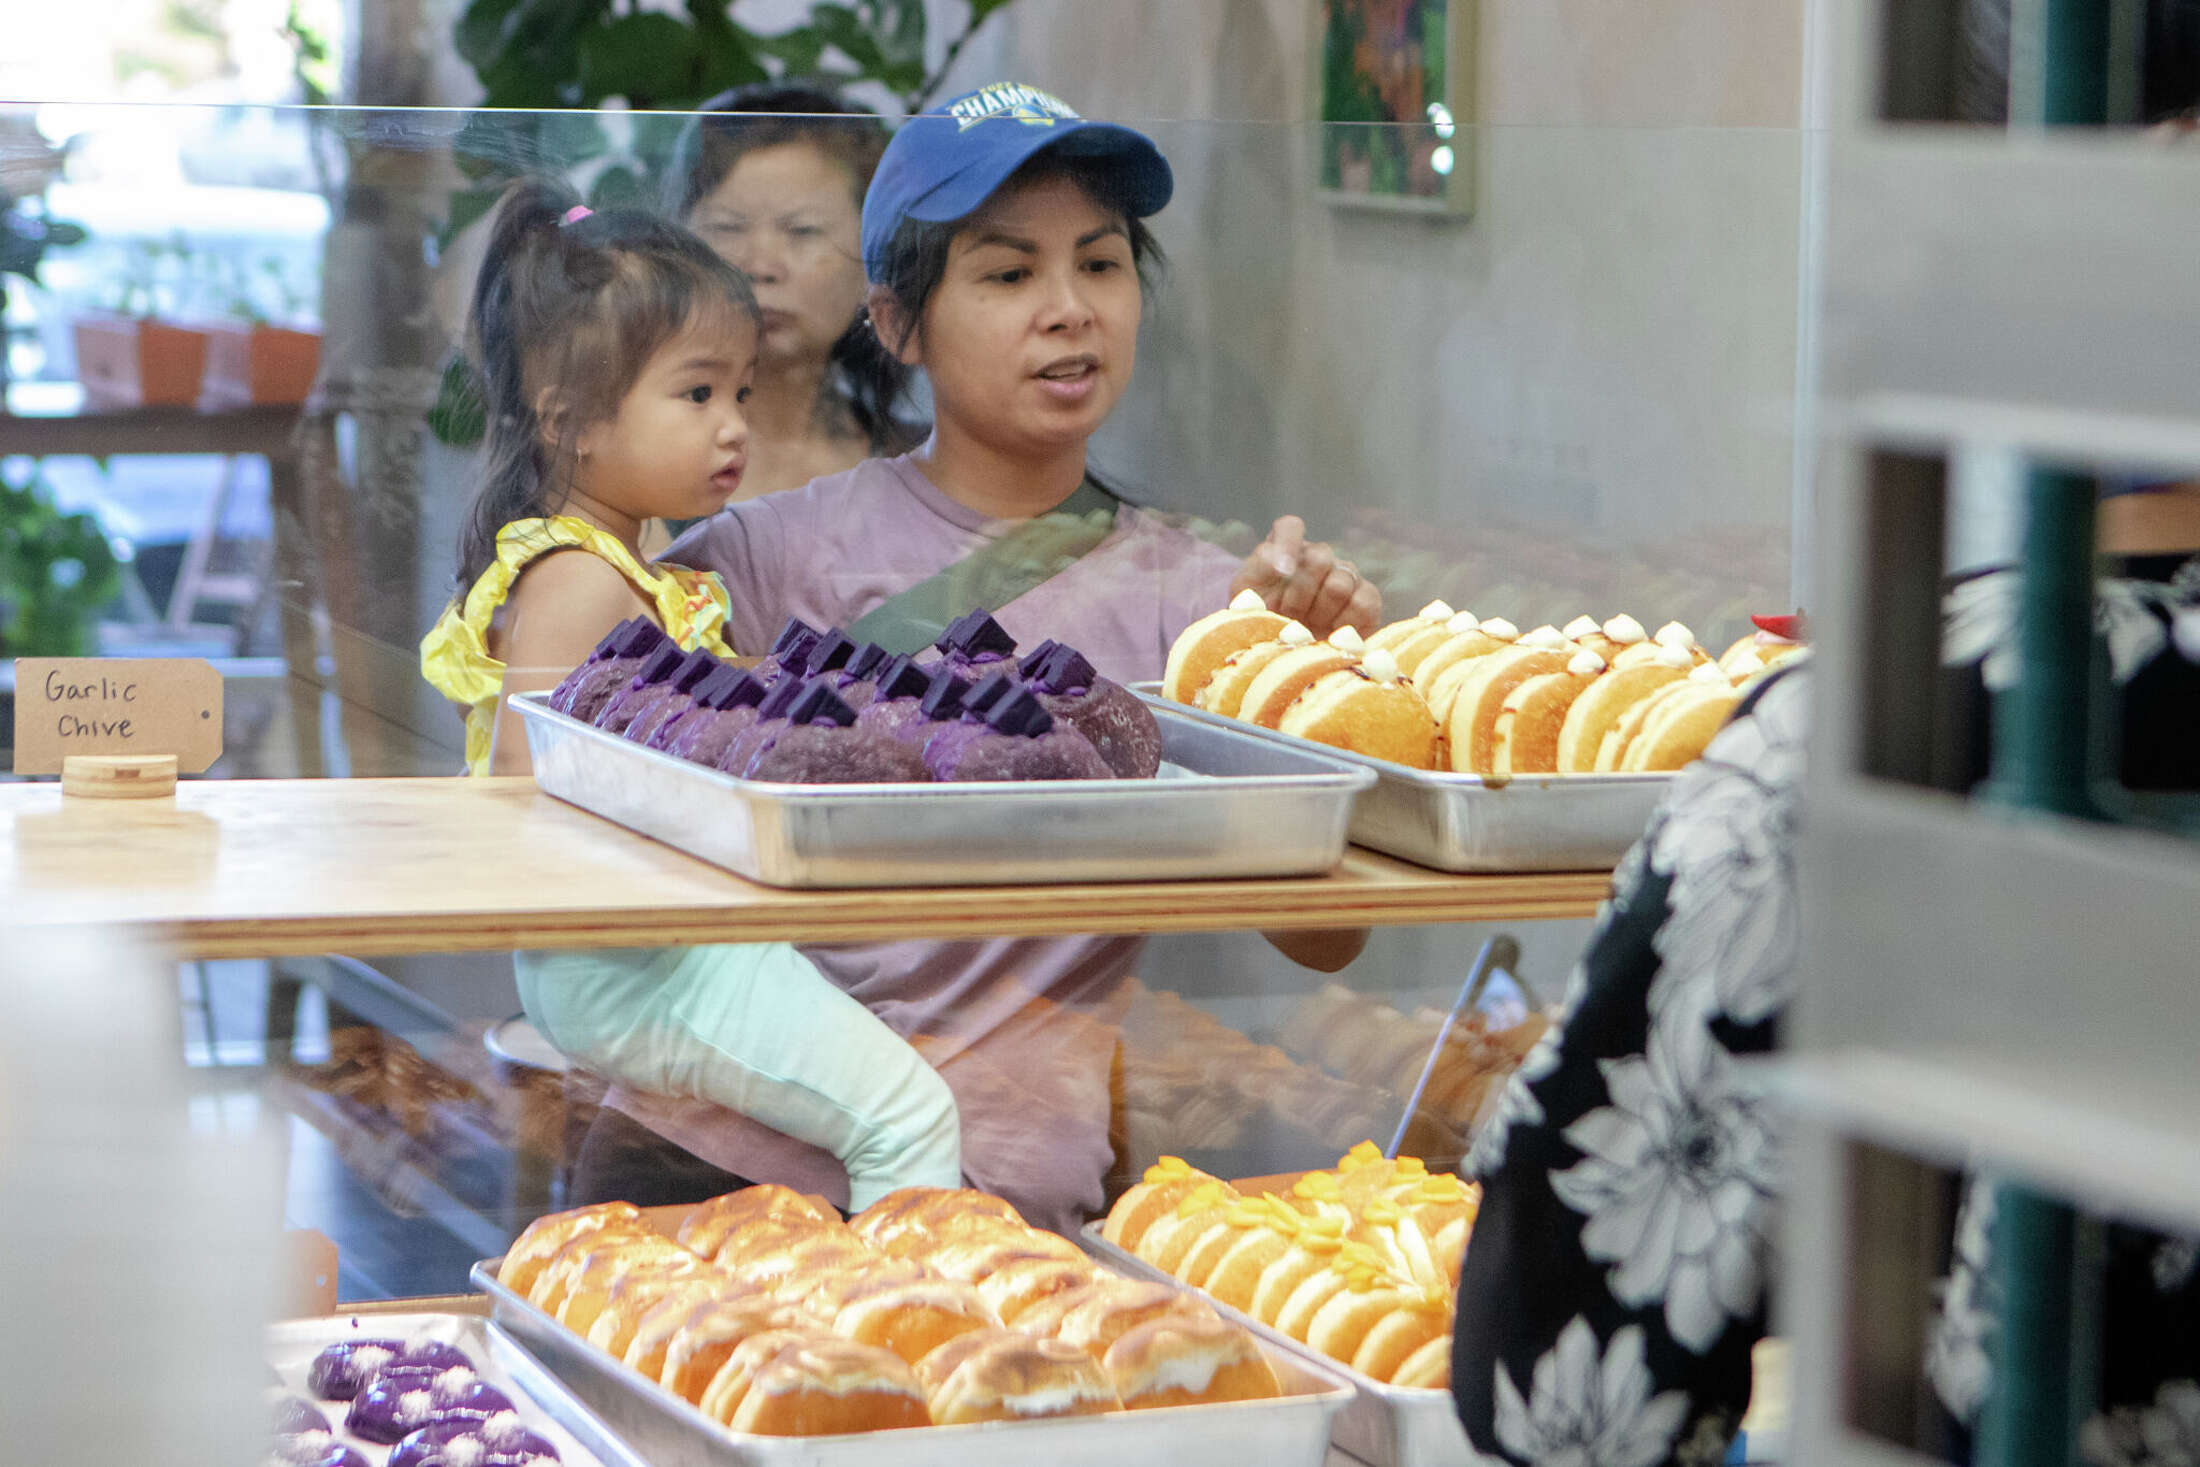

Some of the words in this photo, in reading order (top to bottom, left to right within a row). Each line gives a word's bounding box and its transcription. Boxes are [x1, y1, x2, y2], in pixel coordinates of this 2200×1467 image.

[951, 86, 1081, 127] CHAMPI
[46, 669, 137, 702] Garlic
[58, 714, 136, 738] Chive
